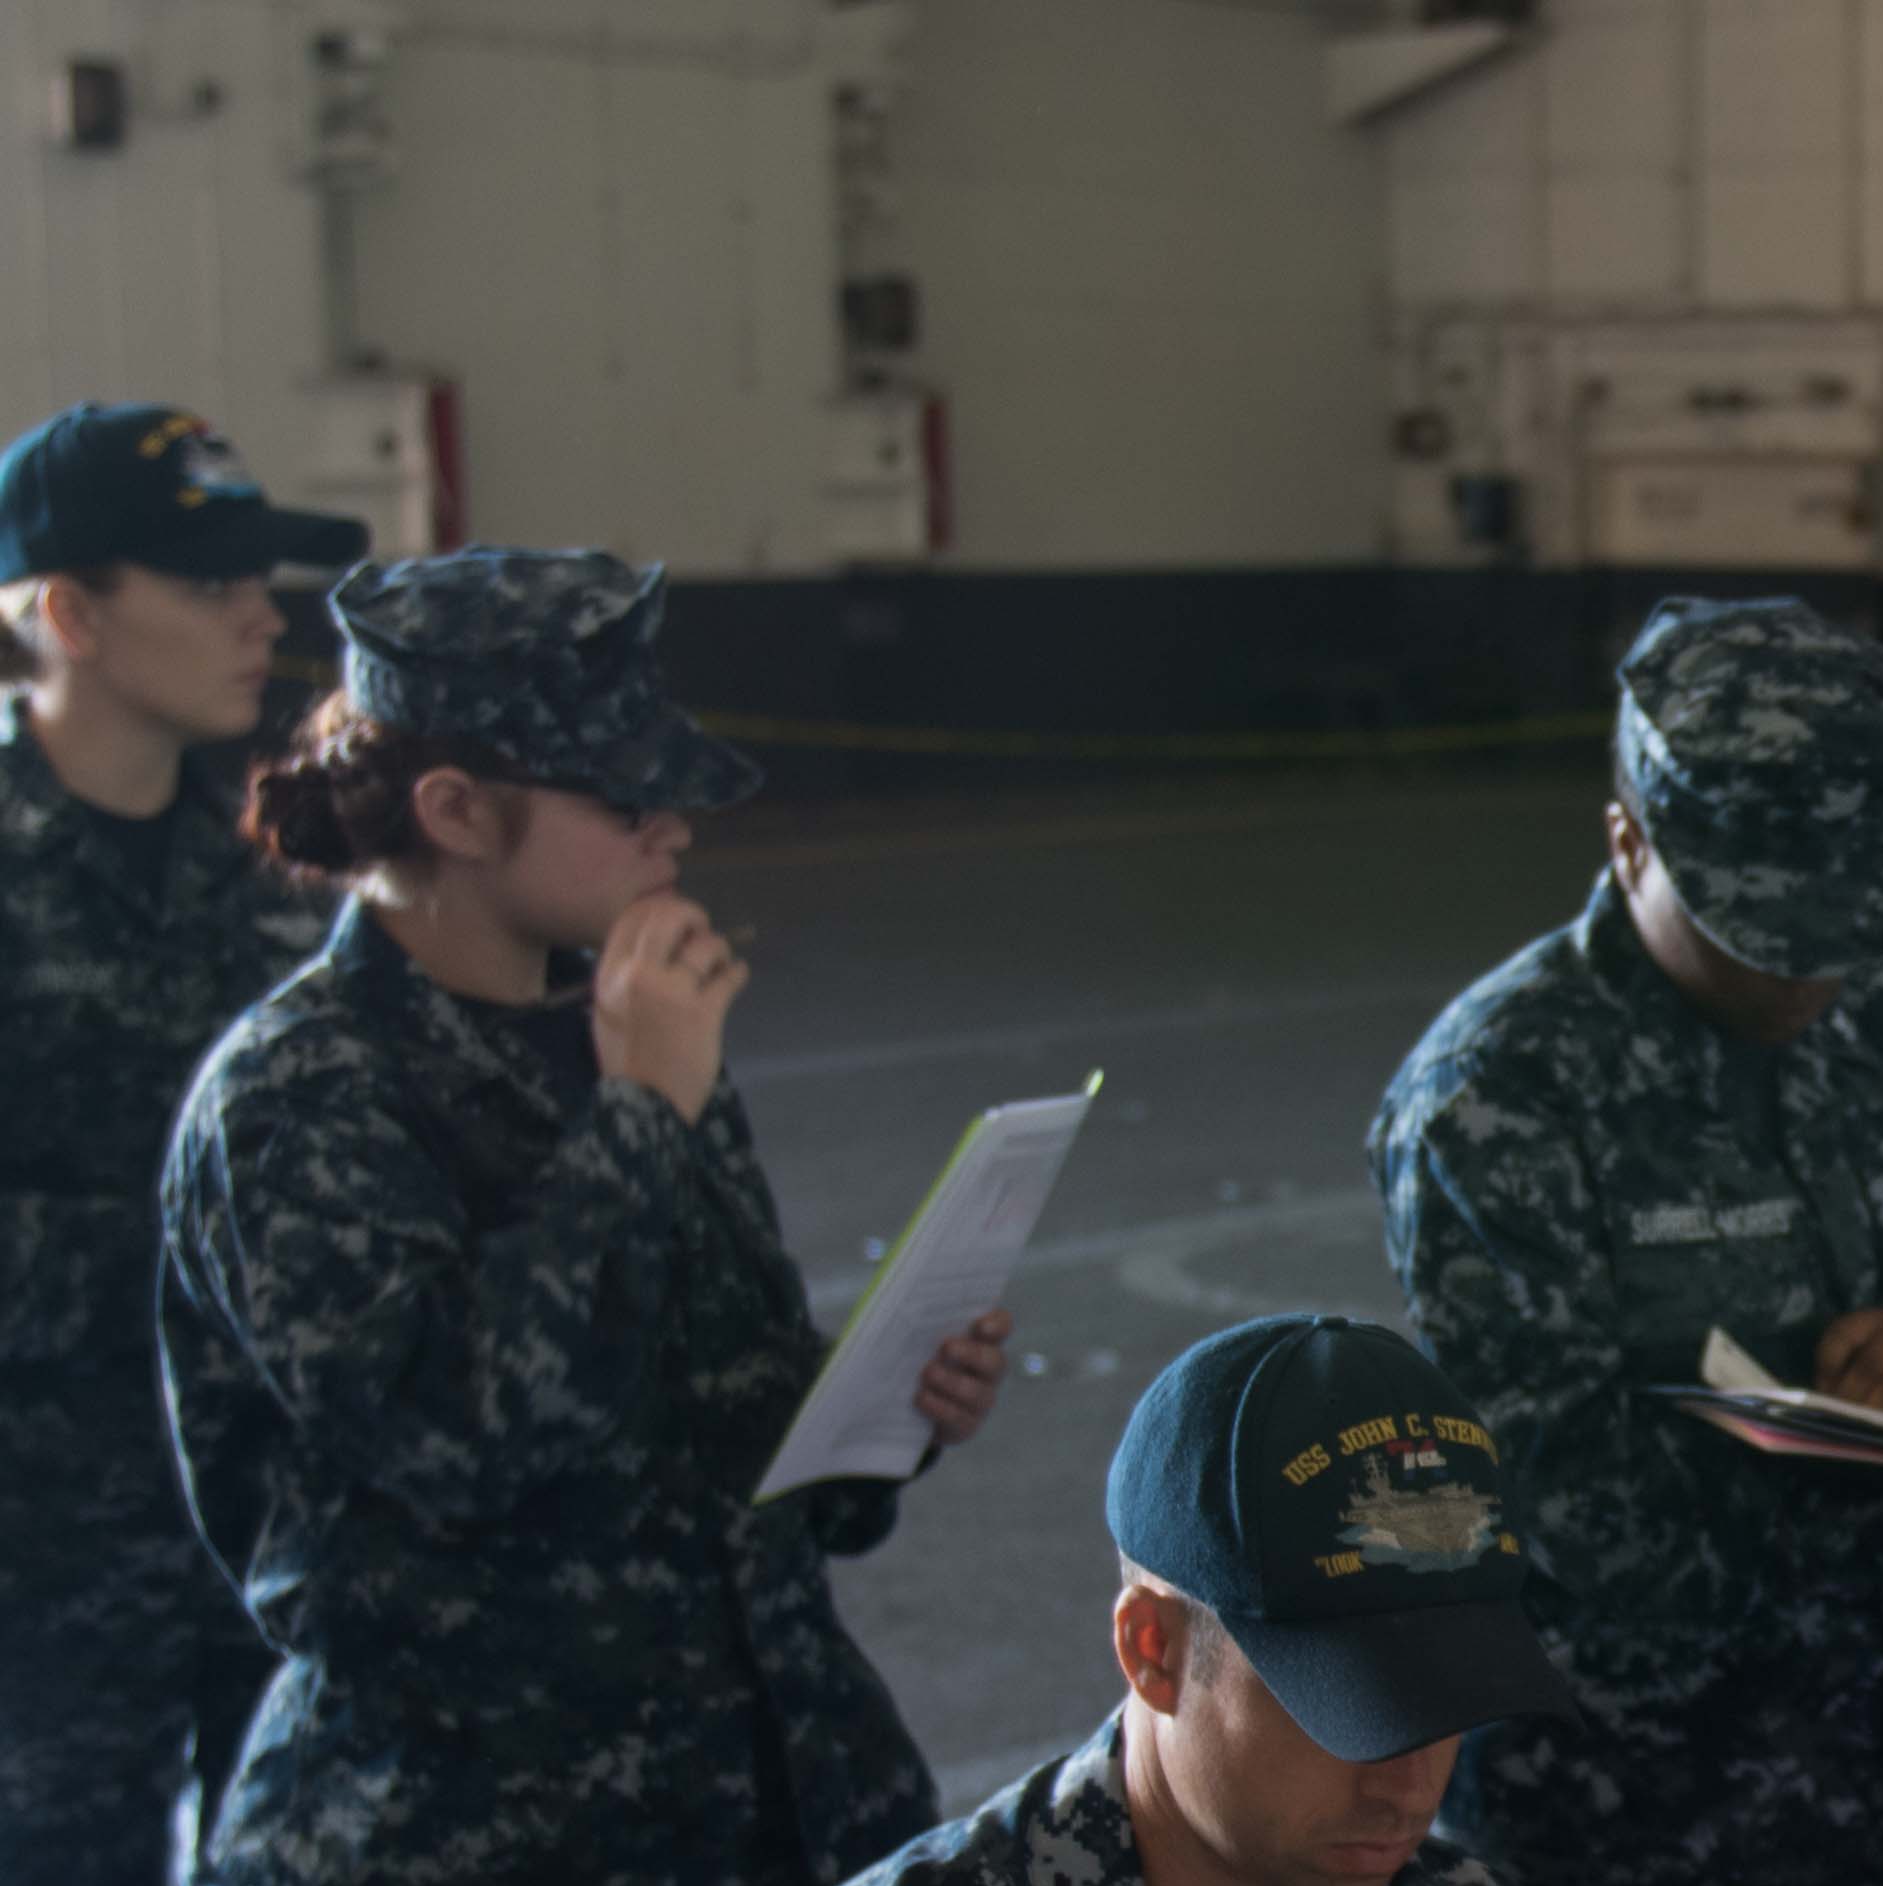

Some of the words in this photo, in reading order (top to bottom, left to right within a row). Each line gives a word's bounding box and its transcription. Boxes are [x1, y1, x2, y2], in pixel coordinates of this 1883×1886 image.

[1282, 1443, 1331, 1486] USS
[1338, 1416, 1399, 1456] JOHN
[1405, 1413, 1428, 1437] C.
